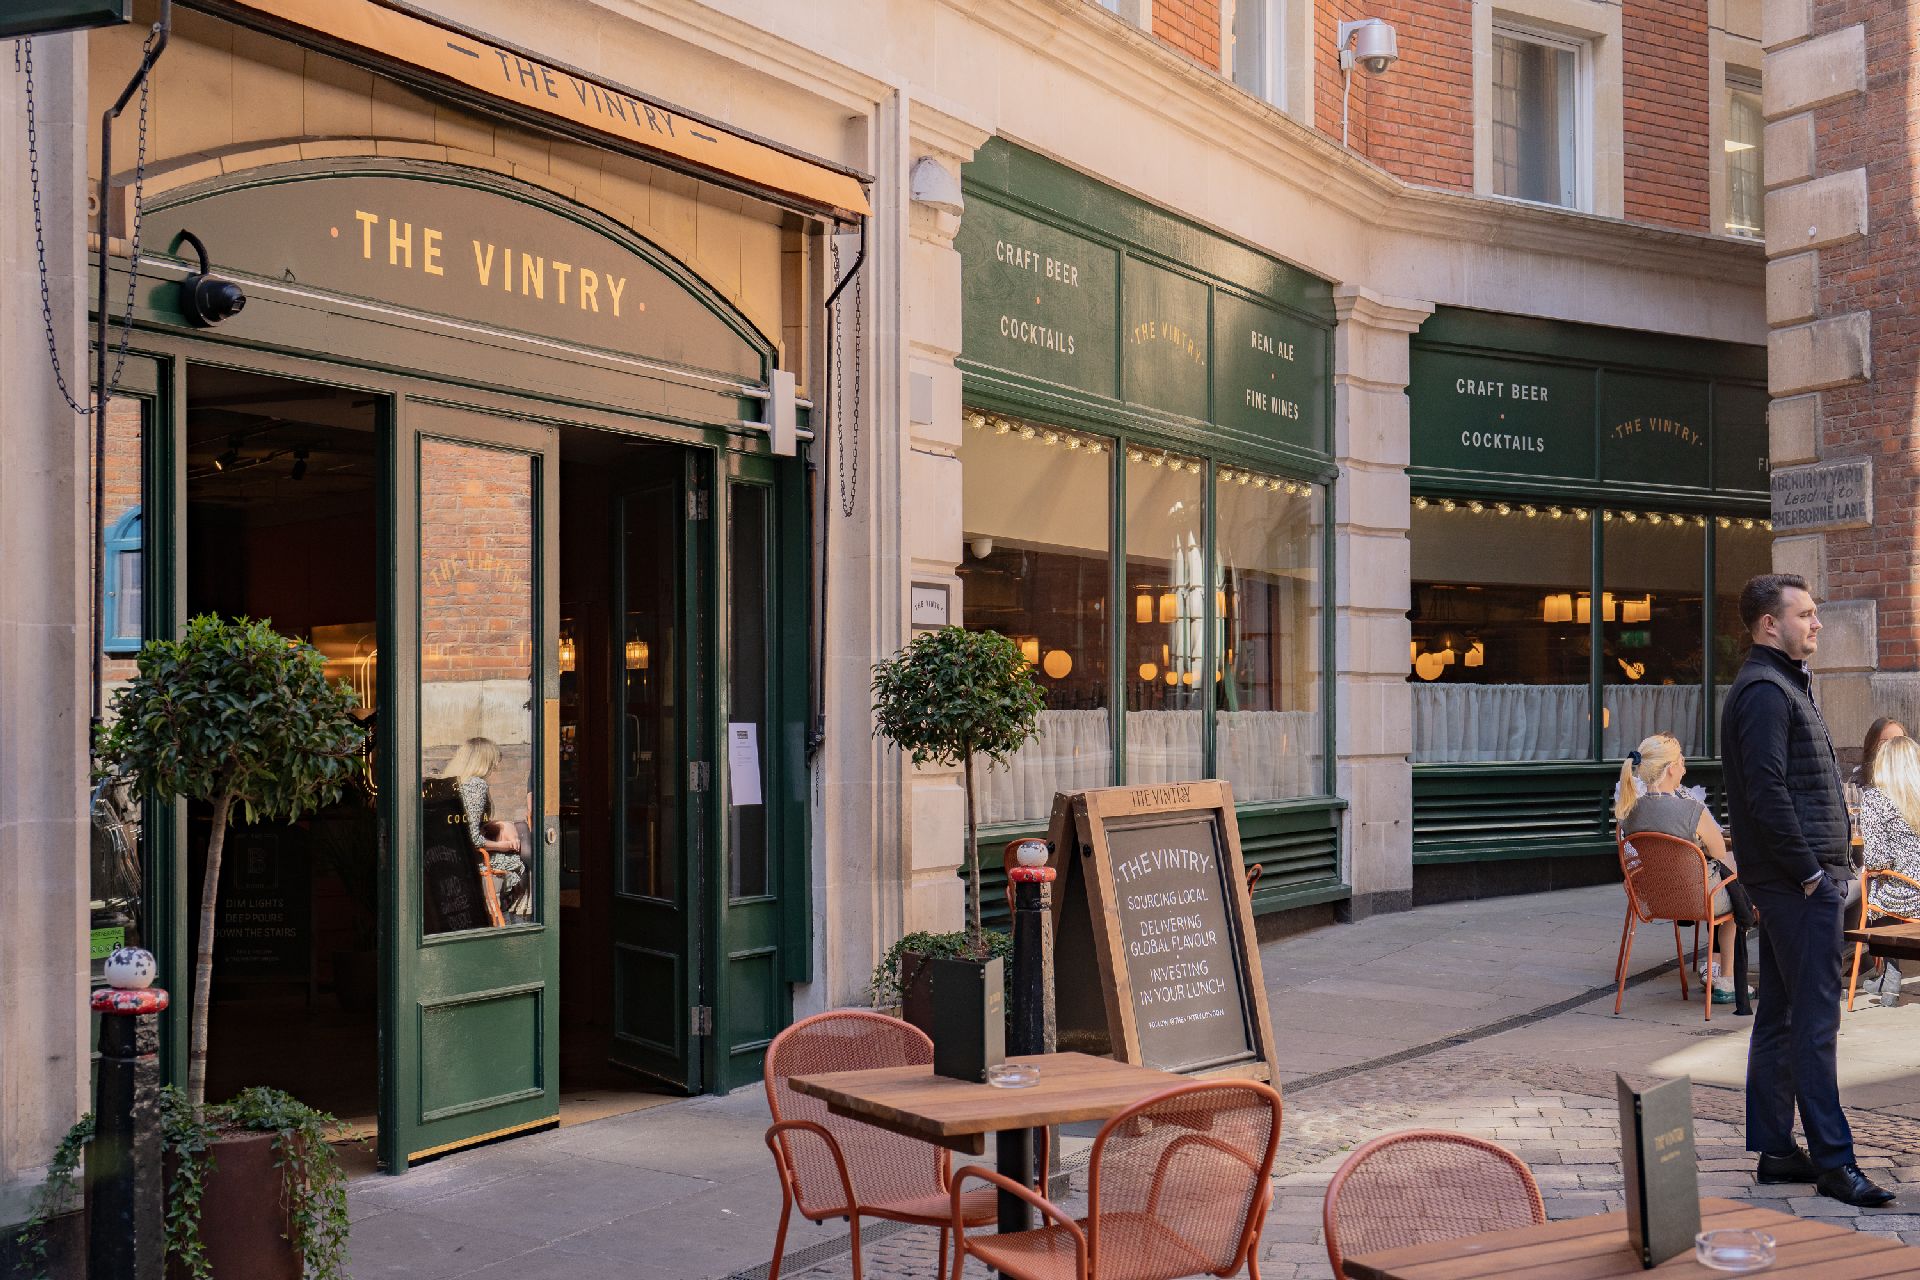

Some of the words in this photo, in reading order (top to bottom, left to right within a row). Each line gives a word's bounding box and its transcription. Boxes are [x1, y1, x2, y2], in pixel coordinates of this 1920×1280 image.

[495, 50, 558, 99] THE
[568, 77, 678, 138] VINTRY
[355, 210, 444, 276] THE
[472, 239, 626, 317] VINTRY
[996, 239, 1040, 273] CRAFT
[1046, 257, 1079, 288] BEER
[1000, 314, 1075, 355] COCKTAILS
[1135, 321, 1155, 344] THE
[1162, 321, 1201, 363] VINTRY
[1251, 330, 1274, 354] REAL
[1278, 341, 1294, 361] ALE
[1456, 378, 1504, 398] CRAFT
[1512, 383, 1548, 401] BEER
[1246, 389, 1267, 411] FINE
[1271, 396, 1299, 421] WINES
[1461, 430, 1544, 452] COCKTAILS
[1615, 418, 1642, 438] THE
[1649, 417, 1699, 445] VINTRY
[1771, 471, 1826, 492] ABCHURCH
[1830, 466, 1862, 485] YARD
[1838, 486, 1853, 498] to
[1771, 505, 1834, 527] SHERBORNE
[1837, 501, 1866, 520] LANE
[1130, 789, 1151, 807] THE
[1152, 786, 1190, 804] VINTRY
[1118, 856, 1151, 884] THE
[1151, 848, 1210, 877] VINTRY
[1128, 891, 1177, 911] SOURCING
[1178, 887, 1209, 903] LOCAL
[245, 928, 262, 937] THE
[263, 928, 297, 937] STAIRS
[1140, 914, 1202, 937] DELIVERING
[1131, 935, 1171, 957] GLOBAL
[1171, 931, 1217, 951] FLAVOUR
[1150, 960, 1209, 983] INVESTING
[1140, 990, 1153, 1006] IN
[1153, 985, 1187, 1003] YOUR
[1187, 978, 1226, 1000] LUNCH
